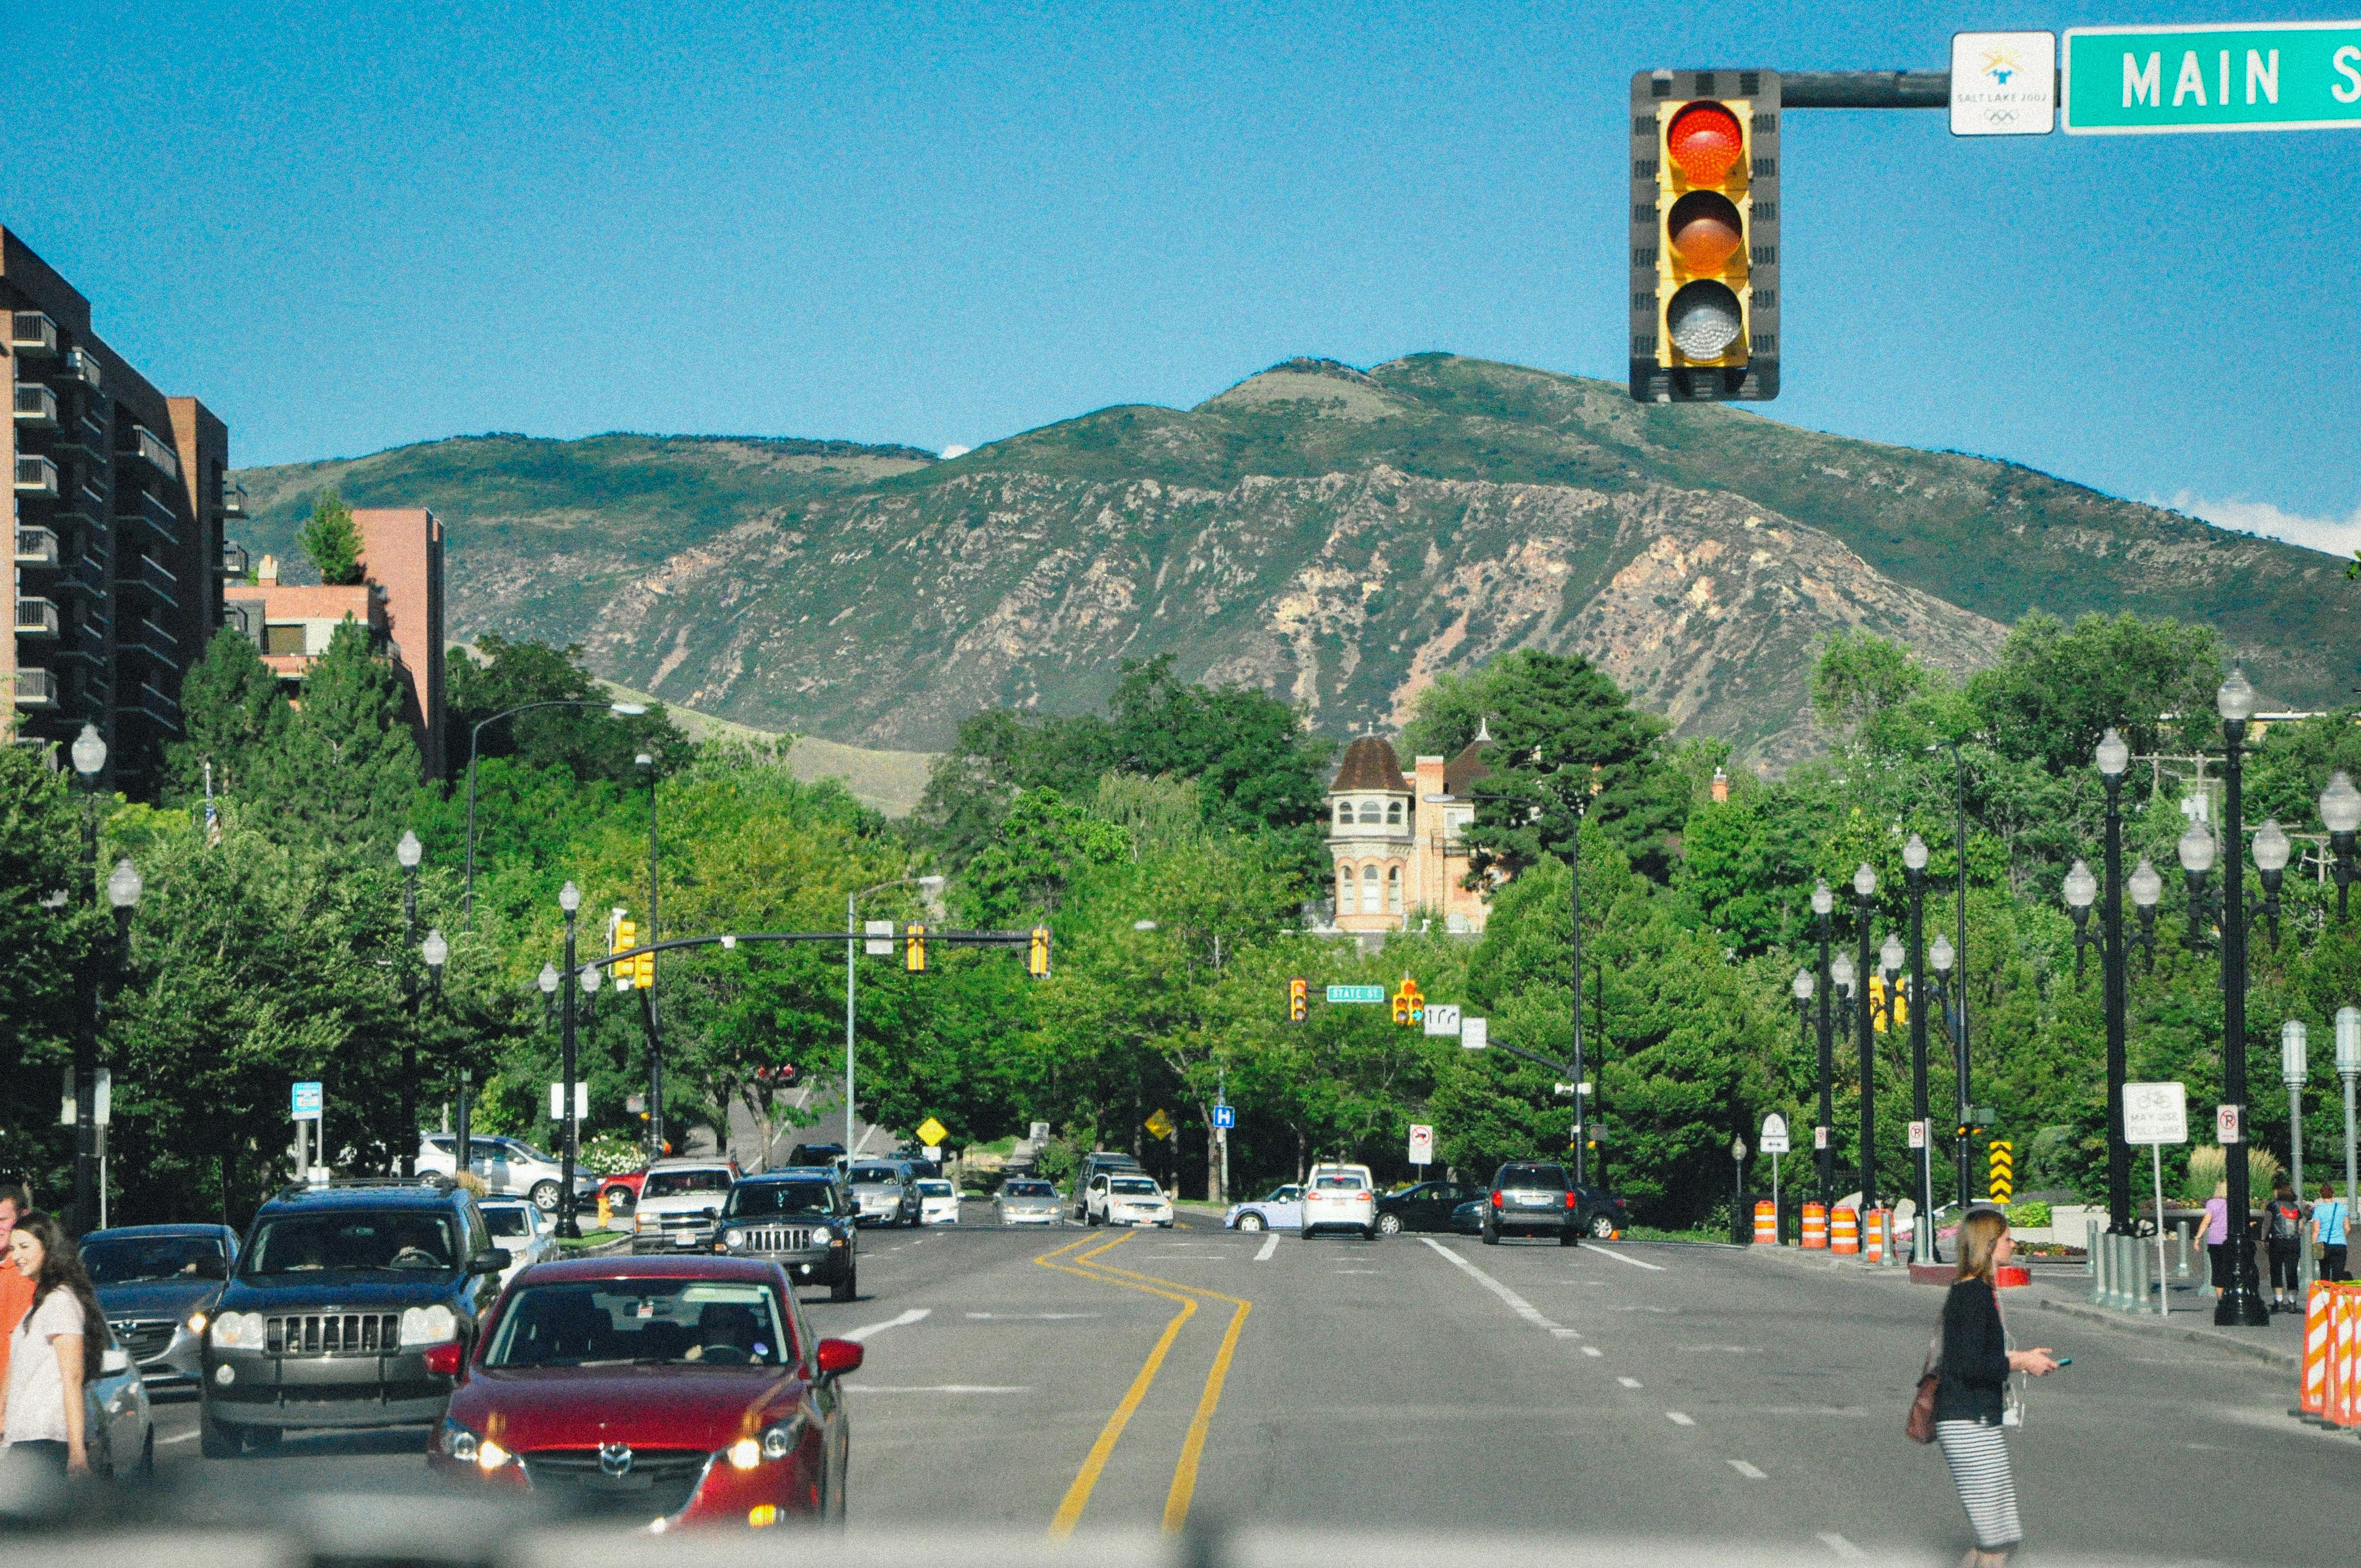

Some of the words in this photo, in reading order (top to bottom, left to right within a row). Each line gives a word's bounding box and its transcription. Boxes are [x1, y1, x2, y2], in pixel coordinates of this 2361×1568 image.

[2122, 48, 2279, 107] MAIN
[1958, 94, 1983, 102] SALT
[1988, 93, 2016, 102] LAKE
[2021, 92, 2047, 101] 2002
[1332, 987, 1361, 999] STATE
[1217, 1109, 1230, 1124] H
[2130, 1113, 2155, 1122] MAY
